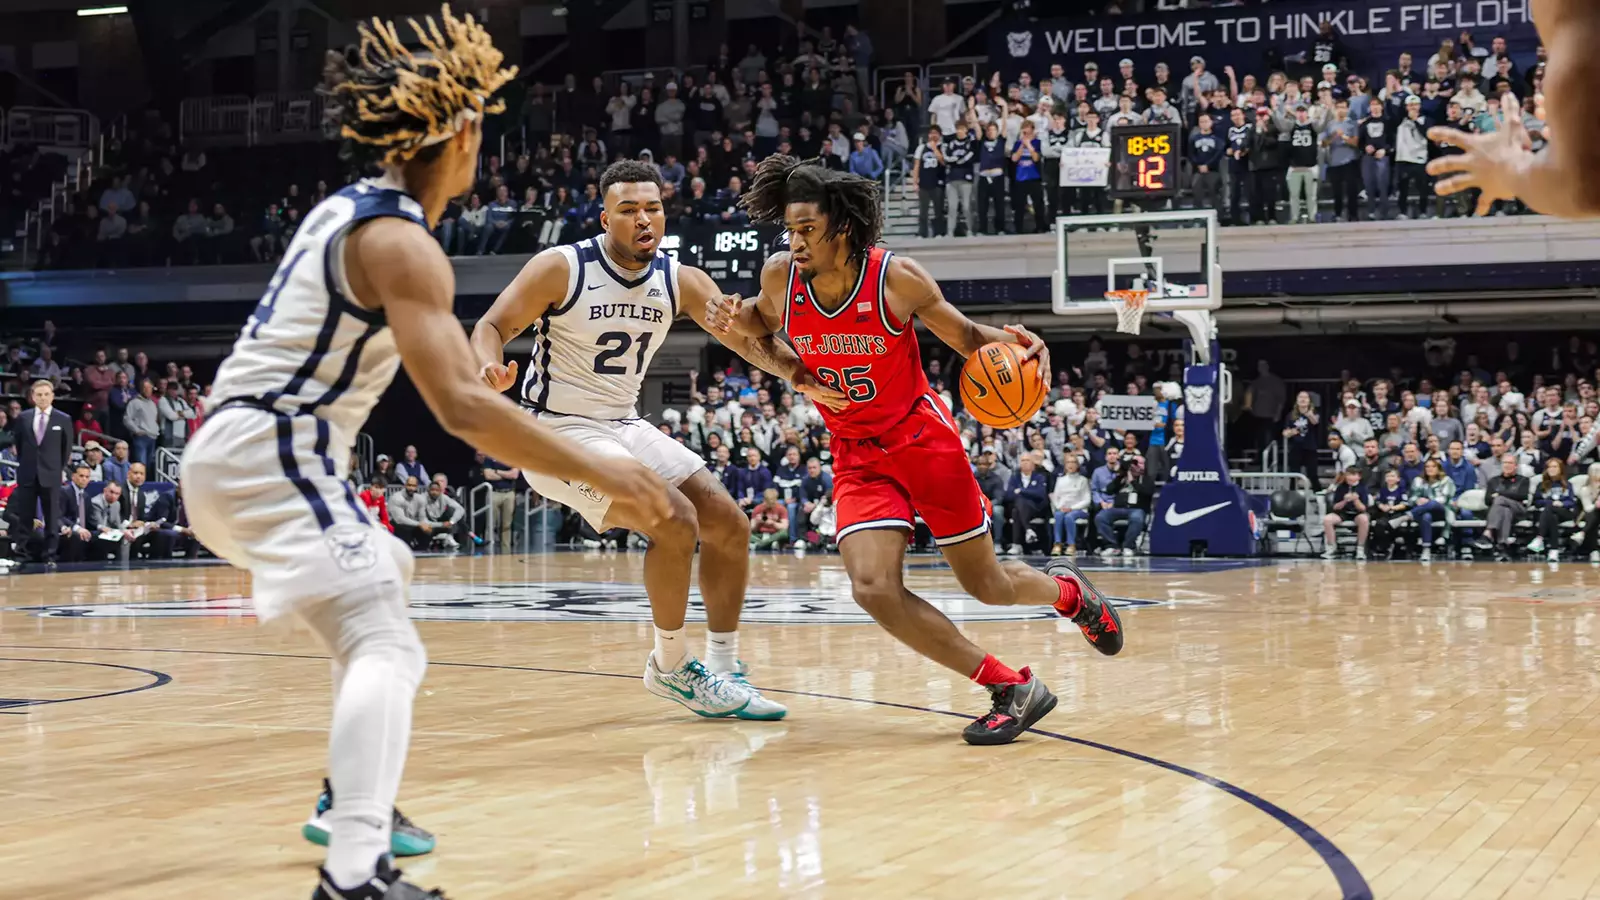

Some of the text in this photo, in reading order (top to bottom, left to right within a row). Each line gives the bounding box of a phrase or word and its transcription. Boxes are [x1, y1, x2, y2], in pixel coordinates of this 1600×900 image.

[1045, 0, 1535, 54] WELCOME TO HINKLE FIELDH
[1127, 134, 1171, 156] 18:45
[1138, 156, 1166, 189] 12
[715, 230, 758, 252] 18:45
[589, 303, 663, 324] BUTLER
[593, 331, 653, 375] 21
[816, 333, 888, 356] JOHN'S
[986, 347, 1013, 386] ELITE
[816, 362, 878, 403] 35
[1101, 405, 1153, 421] DEFENSE
[1178, 471, 1220, 481] BUTLER
